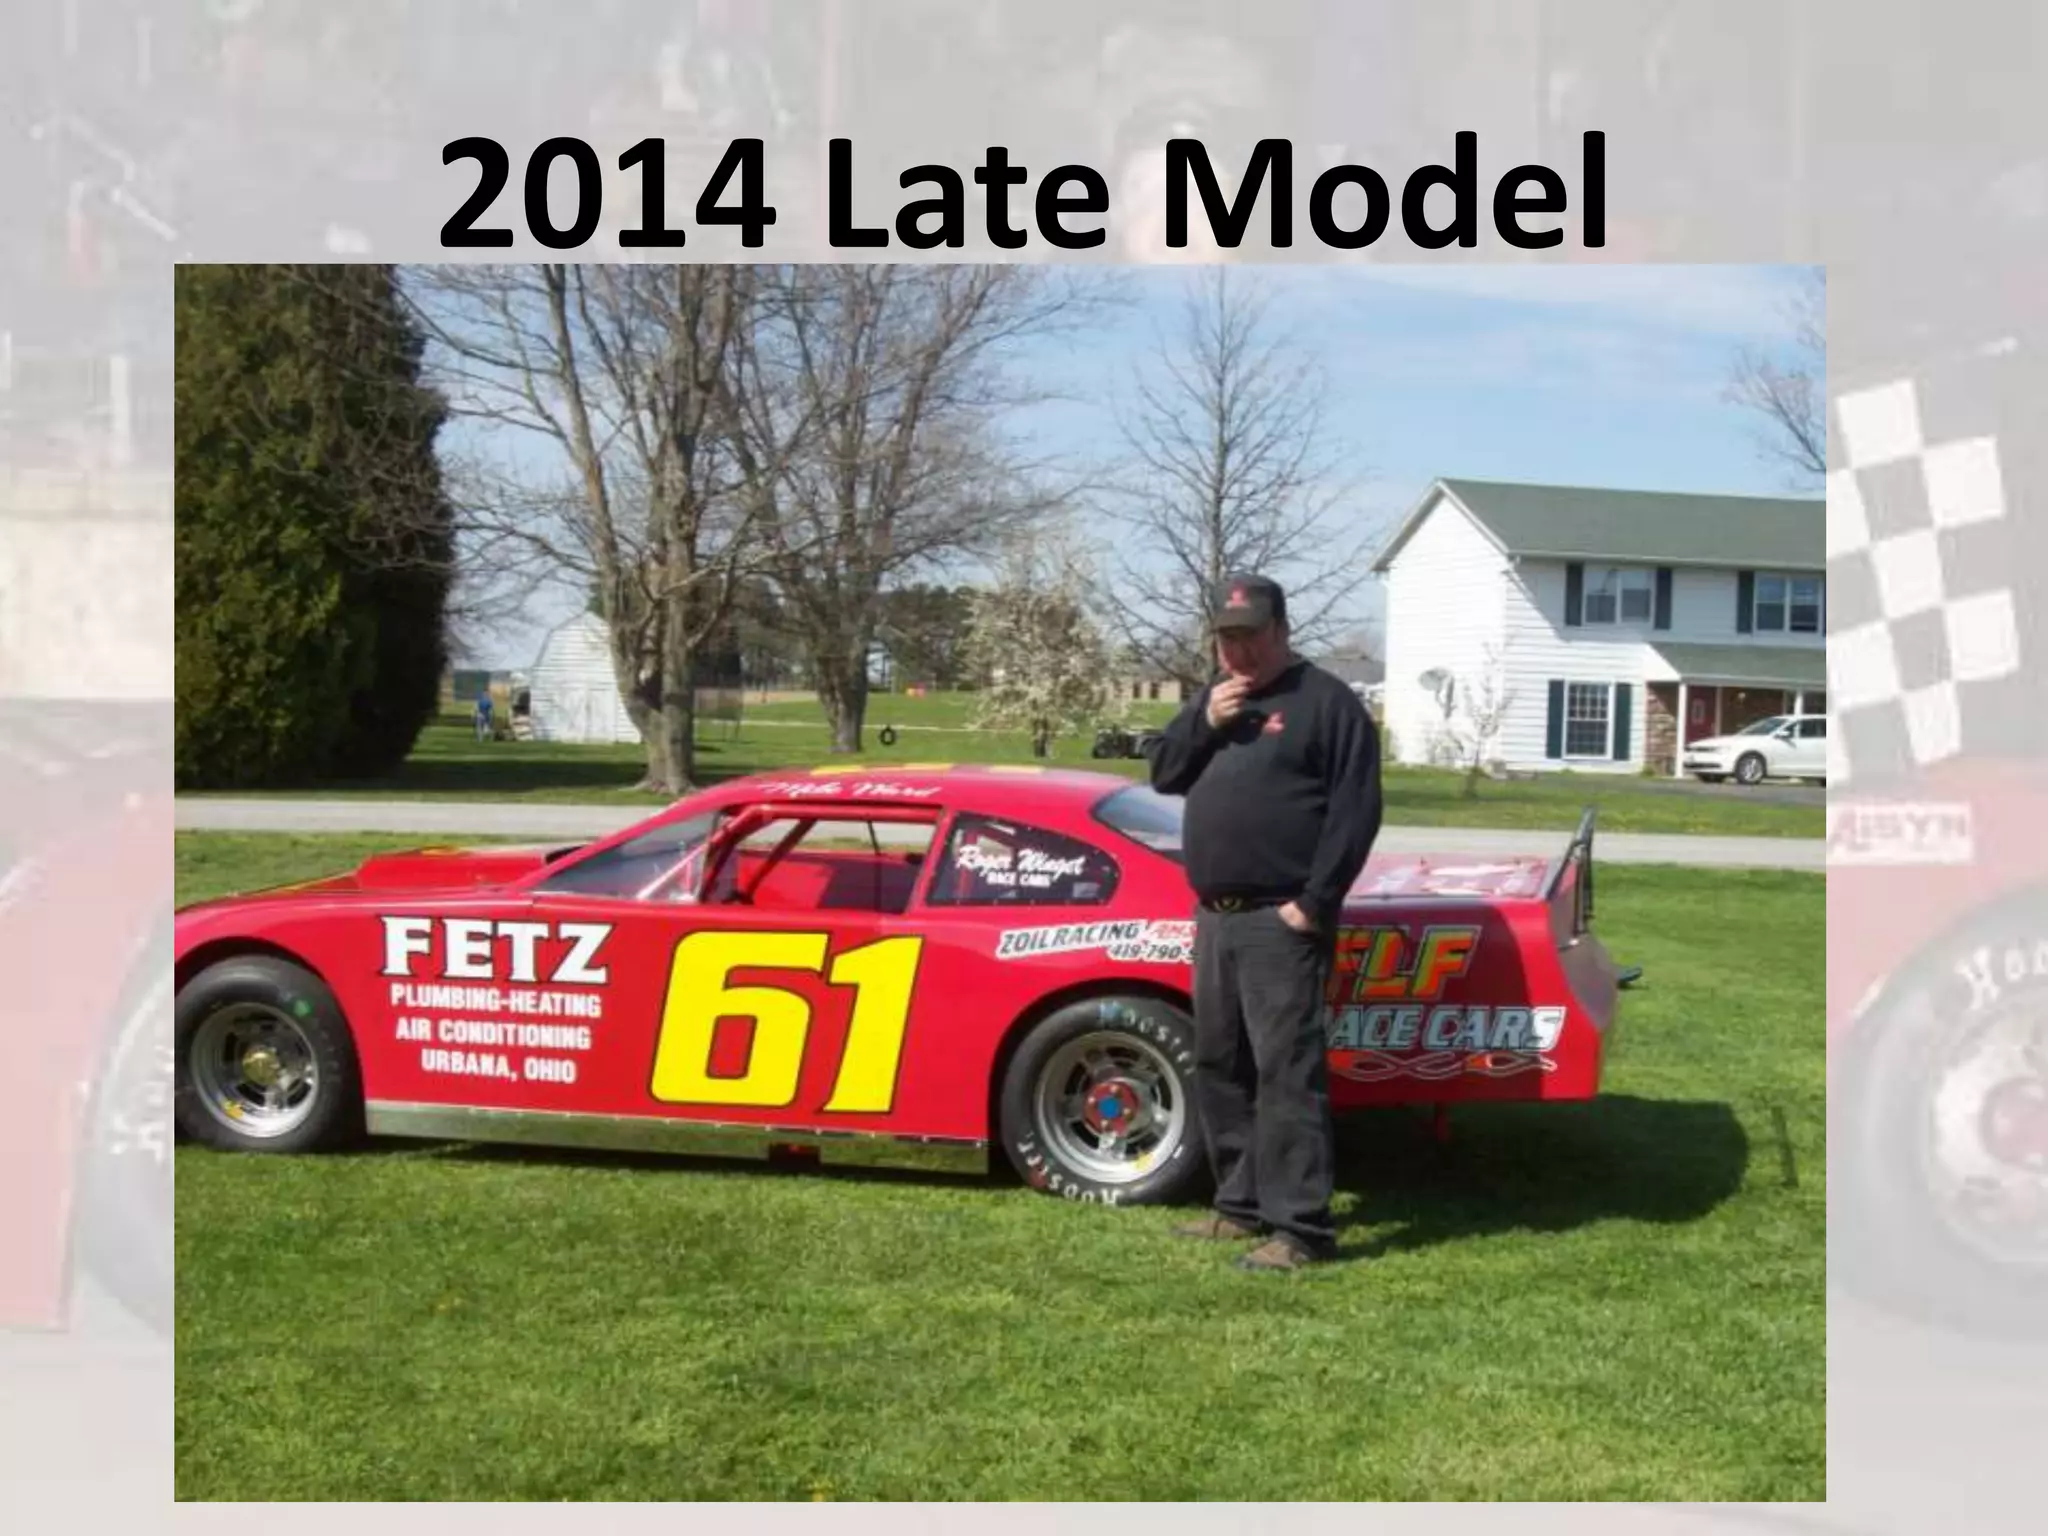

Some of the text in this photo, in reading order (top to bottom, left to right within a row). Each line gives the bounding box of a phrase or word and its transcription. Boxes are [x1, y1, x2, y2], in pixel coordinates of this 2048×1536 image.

[380, 914, 617, 986] FETZ
[391, 982, 602, 1018] PLUMBING-HEATING
[396, 1017, 592, 1050] AIR CONDITIONING
[650, 930, 923, 1115] 61
[1326, 1004, 1567, 1052] ACE CARS
[421, 1048, 577, 1084] URBANA, OHIO
